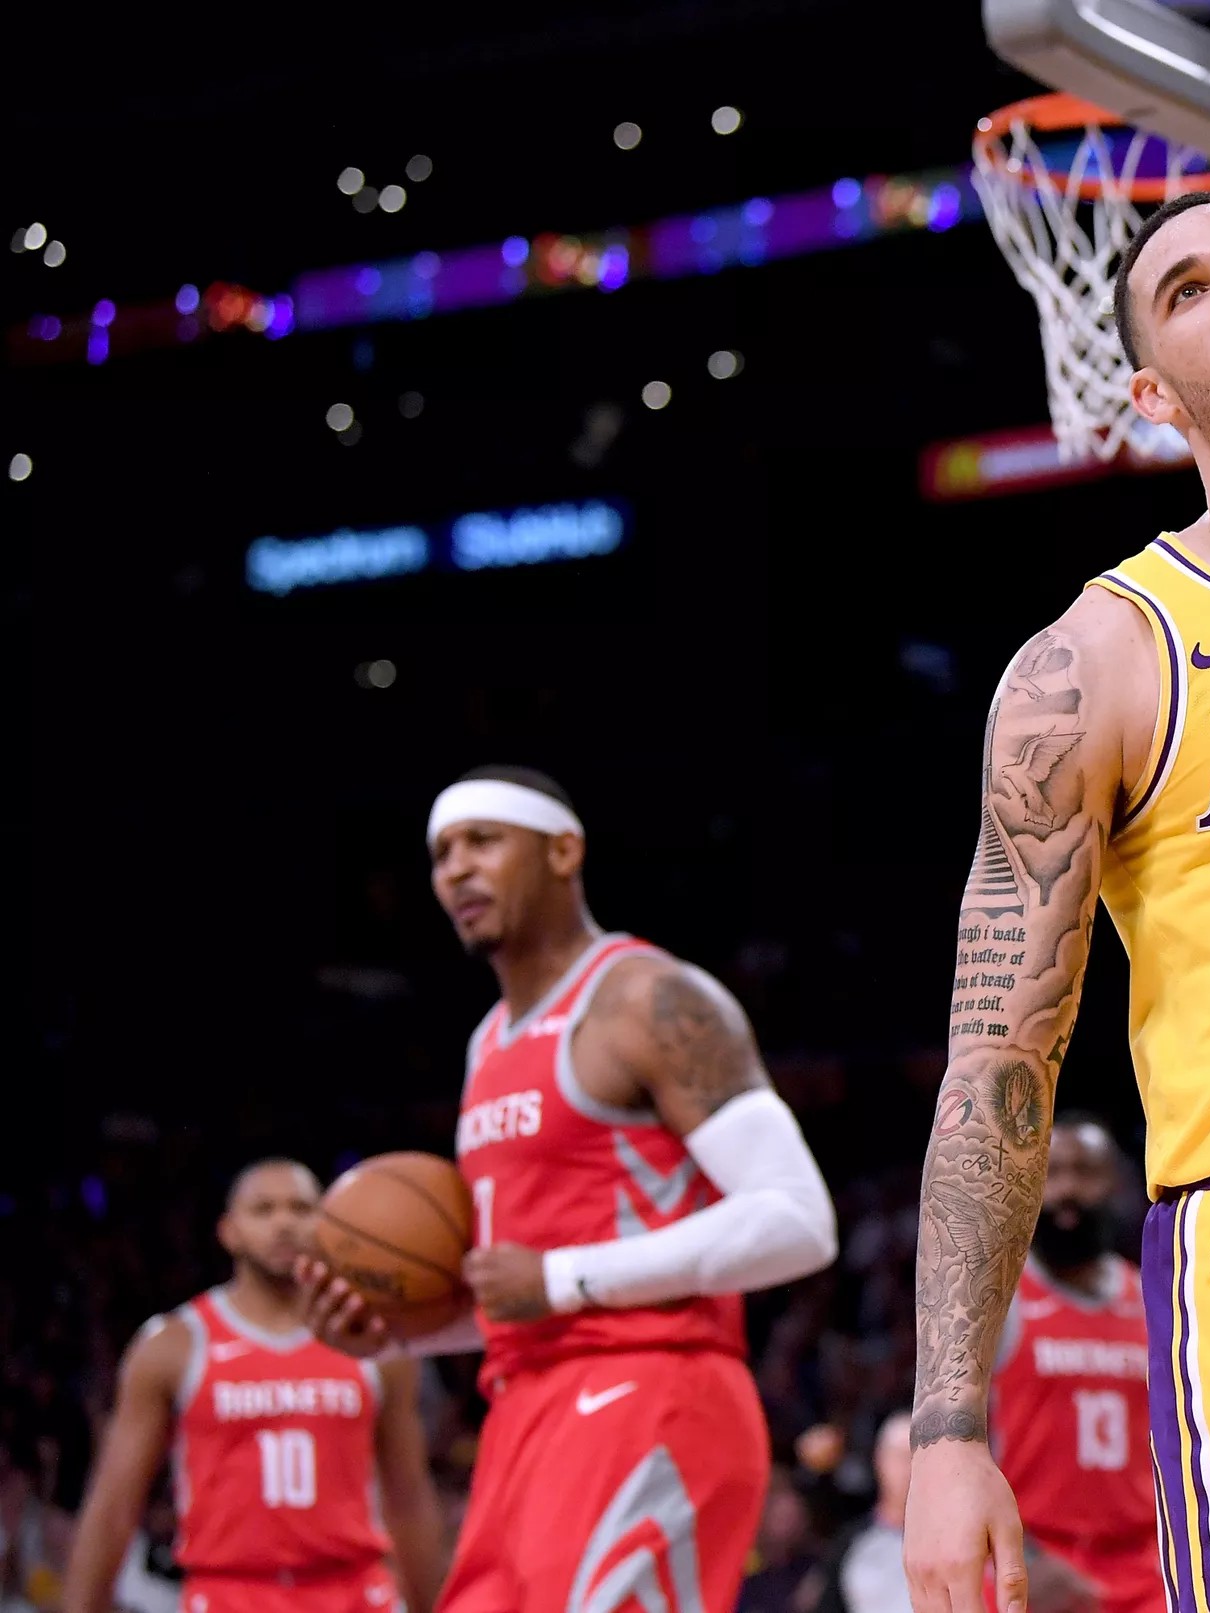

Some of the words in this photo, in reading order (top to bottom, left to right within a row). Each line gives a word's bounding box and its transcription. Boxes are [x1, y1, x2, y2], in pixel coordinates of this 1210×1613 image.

[993, 927, 1026, 942] walk
[1010, 951, 1025, 965] of
[980, 971, 1015, 991] death
[987, 1023, 1009, 1038] me
[212, 1378, 362, 1423] ROCKETS
[1072, 1388, 1129, 1471] 13
[255, 1427, 317, 1510] 10
